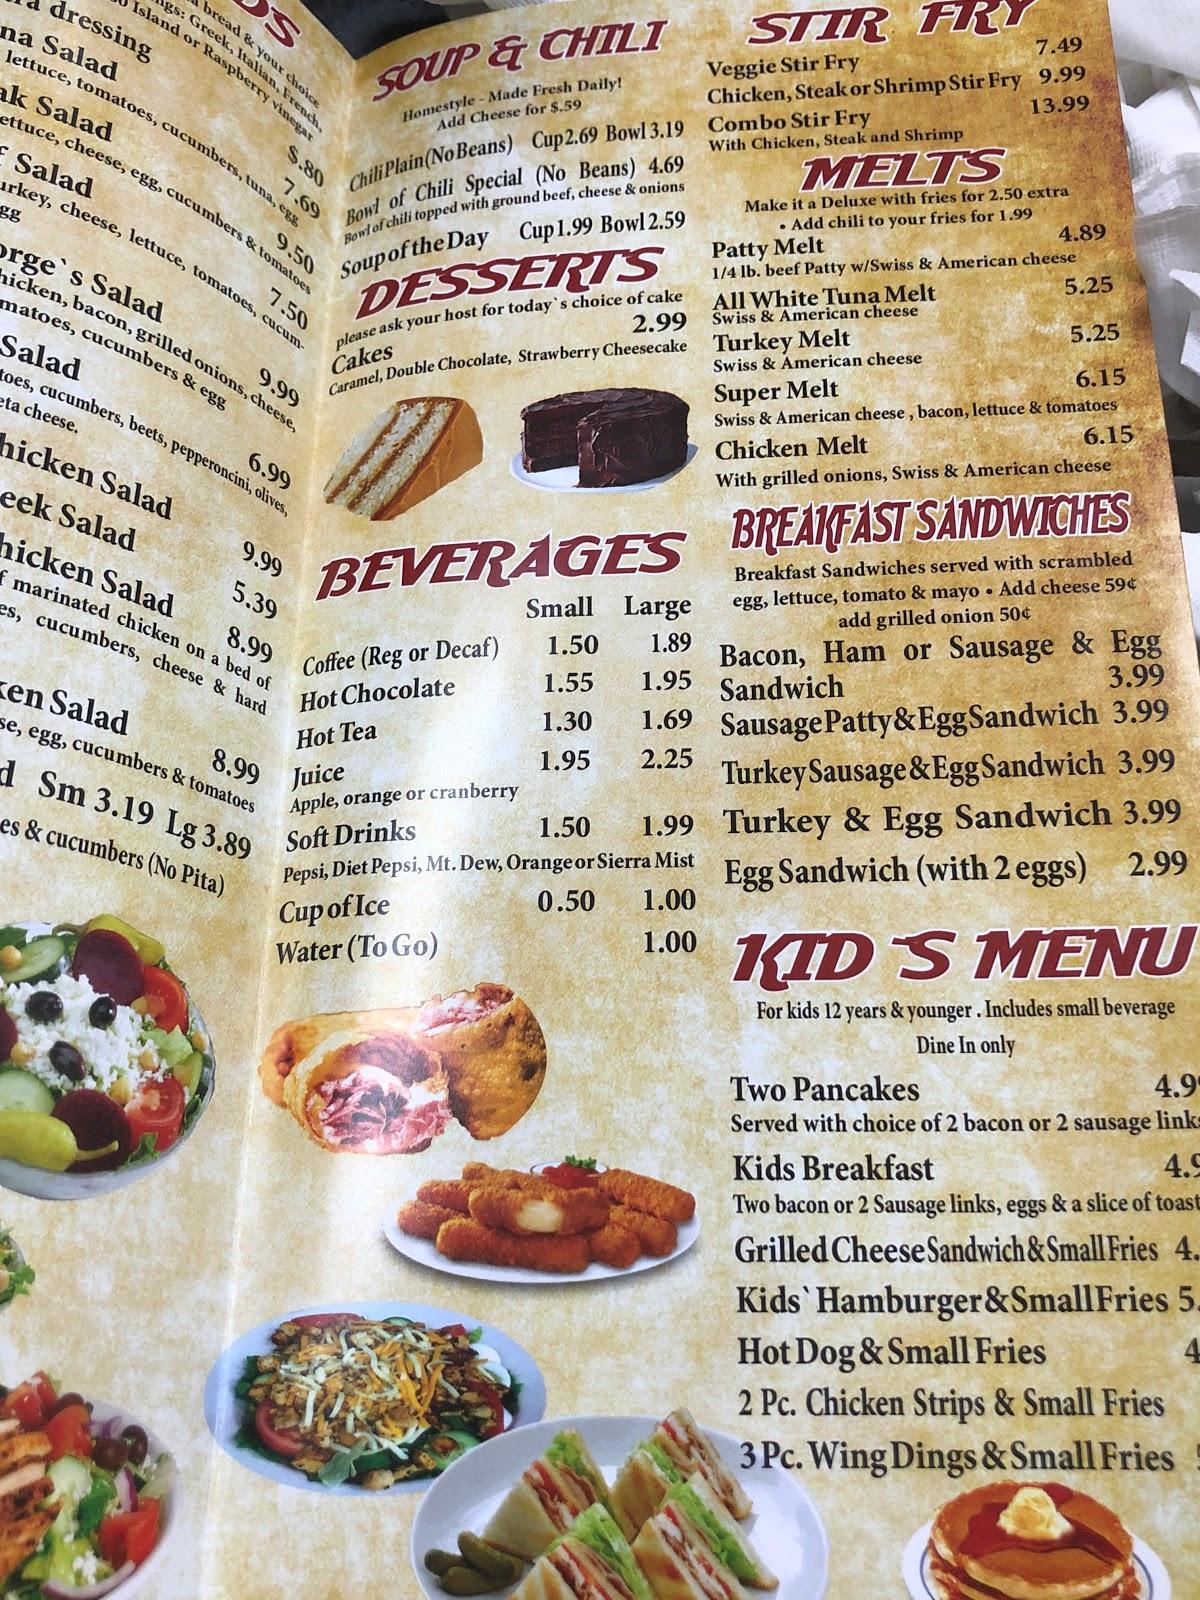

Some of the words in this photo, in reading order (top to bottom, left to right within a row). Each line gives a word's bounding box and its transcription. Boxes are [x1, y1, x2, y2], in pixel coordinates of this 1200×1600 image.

[50, 0, 152, 63] dressing
[748, 6, 888, 44] STIR
[920, 0, 1040, 35] FRY
[42, 36, 118, 81] Salad
[372, 43, 481, 101] SOUP
[488, 35, 527, 70] &
[539, 21, 668, 60] CHILI
[1036, 37, 1082, 55] 7.49
[707, 59, 776, 80] Veggie
[781, 56, 819, 72] Stir
[824, 54, 859, 73] Fry
[1039, 66, 1086, 84] 9.99
[36, 96, 112, 142] Salad
[403, 96, 475, 122] Homestyle
[489, 87, 528, 102] Made
[533, 81, 572, 96] Fresh
[578, 77, 621, 92] Daily!
[437, 114, 465, 131] Add
[470, 109, 520, 123] Cheese
[526, 104, 546, 115] for
[551, 100, 581, 113] $.59
[1031, 96, 1091, 114] 13.99
[6, 50, 71, 85] lettuce,
[77, 78, 157, 126] tomatoes,
[162, 122, 242, 181] cucumbers,
[246, 175, 276, 207] tuna,
[280, 204, 298, 227] egg
[709, 138, 746, 151] With
[752, 136, 820, 149] Chicken,
[824, 132, 867, 146] Steak
[871, 130, 900, 142] and
[905, 128, 963, 143] Shrimp
[15, 153, 93, 198] Salad
[288, 146, 324, 187] $.80
[800, 148, 1006, 192] MELTS
[65, 138, 125, 173] cheese,
[131, 169, 162, 192] egg,
[167, 188, 242, 241] cucumbers
[246, 236, 256, 252] &
[260, 246, 310, 294] tomatoes
[284, 177, 320, 218] 7.69
[345, 224, 370, 244] Bowl
[373, 218, 385, 232] of
[386, 211, 411, 228] chili
[415, 201, 457, 221] topped
[461, 196, 488, 211] with
[492, 190, 539, 210] ground
[543, 187, 574, 201] beef,
[579, 186, 621, 198] cheese
[625, 184, 636, 195] &
[639, 182, 684, 194] onions
[277, 233, 314, 274] 9.50
[1059, 224, 1106, 242] 4.89
[92, 274, 162, 323] Salad
[356, 247, 665, 319] DESSERTS
[1066, 276, 1113, 295] 5.25
[271, 287, 307, 330] 7.50
[633, 312, 686, 333] 2.99
[1071, 322, 1120, 343] 5.25
[0, 335, 80, 381] Salad
[329, 370, 382, 396] Caramel,
[386, 360, 434, 380] Double
[438, 353, 511, 370] Chocolate,
[519, 346, 600, 362] Strawberry
[603, 339, 687, 356] Cheesecake
[332, 346, 392, 374] Cakes
[260, 368, 299, 407] 9.99
[249, 453, 290, 489] 6.99
[101, 471, 172, 520] Salad
[59, 505, 136, 552] Salad
[730, 499, 913, 556] BREAKFAST
[915, 491, 1132, 545] SANDWICHES
[243, 541, 282, 577] 9.99
[316, 528, 688, 601] BEVERAGES
[735, 564, 816, 581] Breakfast
[822, 560, 925, 578] Sandwiches
[930, 556, 989, 573] served
[994, 554, 1033, 570] with
[1039, 550, 1134, 569] scrambled
[102, 570, 174, 618] Salad
[233, 580, 277, 619] 5.39
[527, 596, 593, 618] Small
[624, 596, 691, 620] Large
[12, 580, 110, 620] marinated
[117, 612, 179, 648] chicken
[186, 644, 204, 660] on
[211, 655, 219, 666] a
[226, 656, 250, 681] bed
[256, 676, 272, 690] of
[228, 626, 272, 663] 8.99
[303, 651, 355, 676] Coffee
[362, 646, 402, 670] (Reg
[409, 648, 429, 662] or
[436, 636, 498, 660] Decaf)
[549, 635, 598, 655] 1.50
[652, 632, 691, 652] 1.89
[300, 690, 338, 712] Hot
[342, 677, 455, 705] Chocolate
[545, 672, 593, 692] 1.55
[643, 670, 691, 690] 1.95
[50, 690, 128, 736] Salad
[296, 727, 335, 750] Hot
[340, 722, 377, 742] Tea
[544, 711, 592, 731] 1.30
[643, 709, 692, 729] 1.69
[212, 749, 259, 784] 8.99
[292, 764, 344, 792] Juice
[541, 750, 590, 770] 1.95
[642, 748, 692, 769] 2.25
[39, 771, 85, 807] Sm
[94, 788, 154, 824] 3.19
[166, 808, 198, 849] Lg
[202, 824, 251, 859] 3.89
[290, 792, 338, 814] Apple,
[344, 791, 402, 806] orange
[406, 790, 425, 800] or
[430, 783, 518, 802] cranberry
[723, 807, 831, 838] Turkey
[844, 807, 870, 832] &
[883, 806, 943, 838] Egg
[956, 800, 1112, 829] Sandwich
[1123, 799, 1181, 824] 3.99
[286, 826, 329, 852] Soft
[333, 820, 415, 846] Drinks
[540, 816, 590, 838] 1.50
[643, 815, 693, 836] 1.99
[1128, 851, 1187, 876] 2.99
[974, 926, 1198, 979] MENU
[757, 1002, 783, 1019] For
[787, 1001, 819, 1019] kids
[825, 1002, 841, 1018] 12
[845, 1006, 886, 1024] years
[891, 1001, 904, 1018] &
[907, 1006, 972, 1023] younger
[985, 998, 1052, 1017] Includes
[1057, 998, 1100, 1016] small
[1102, 997, 1175, 1020] beverage
[917, 1036, 954, 1054] Dine
[958, 1036, 976, 1053] In
[981, 1035, 1015, 1058] only
[733, 1154, 795, 1181] Kids
[802, 1154, 934, 1180] Breakfast
[739, 1390, 752, 1415] 2
[761, 1388, 796, 1416] Pc.
[806, 1387, 904, 1416] Chicken
[914, 1388, 985, 1420] Strips
[994, 1388, 1014, 1416] &
[1024, 1387, 1094, 1416] Small
[1102, 1388, 1164, 1416] Fries
